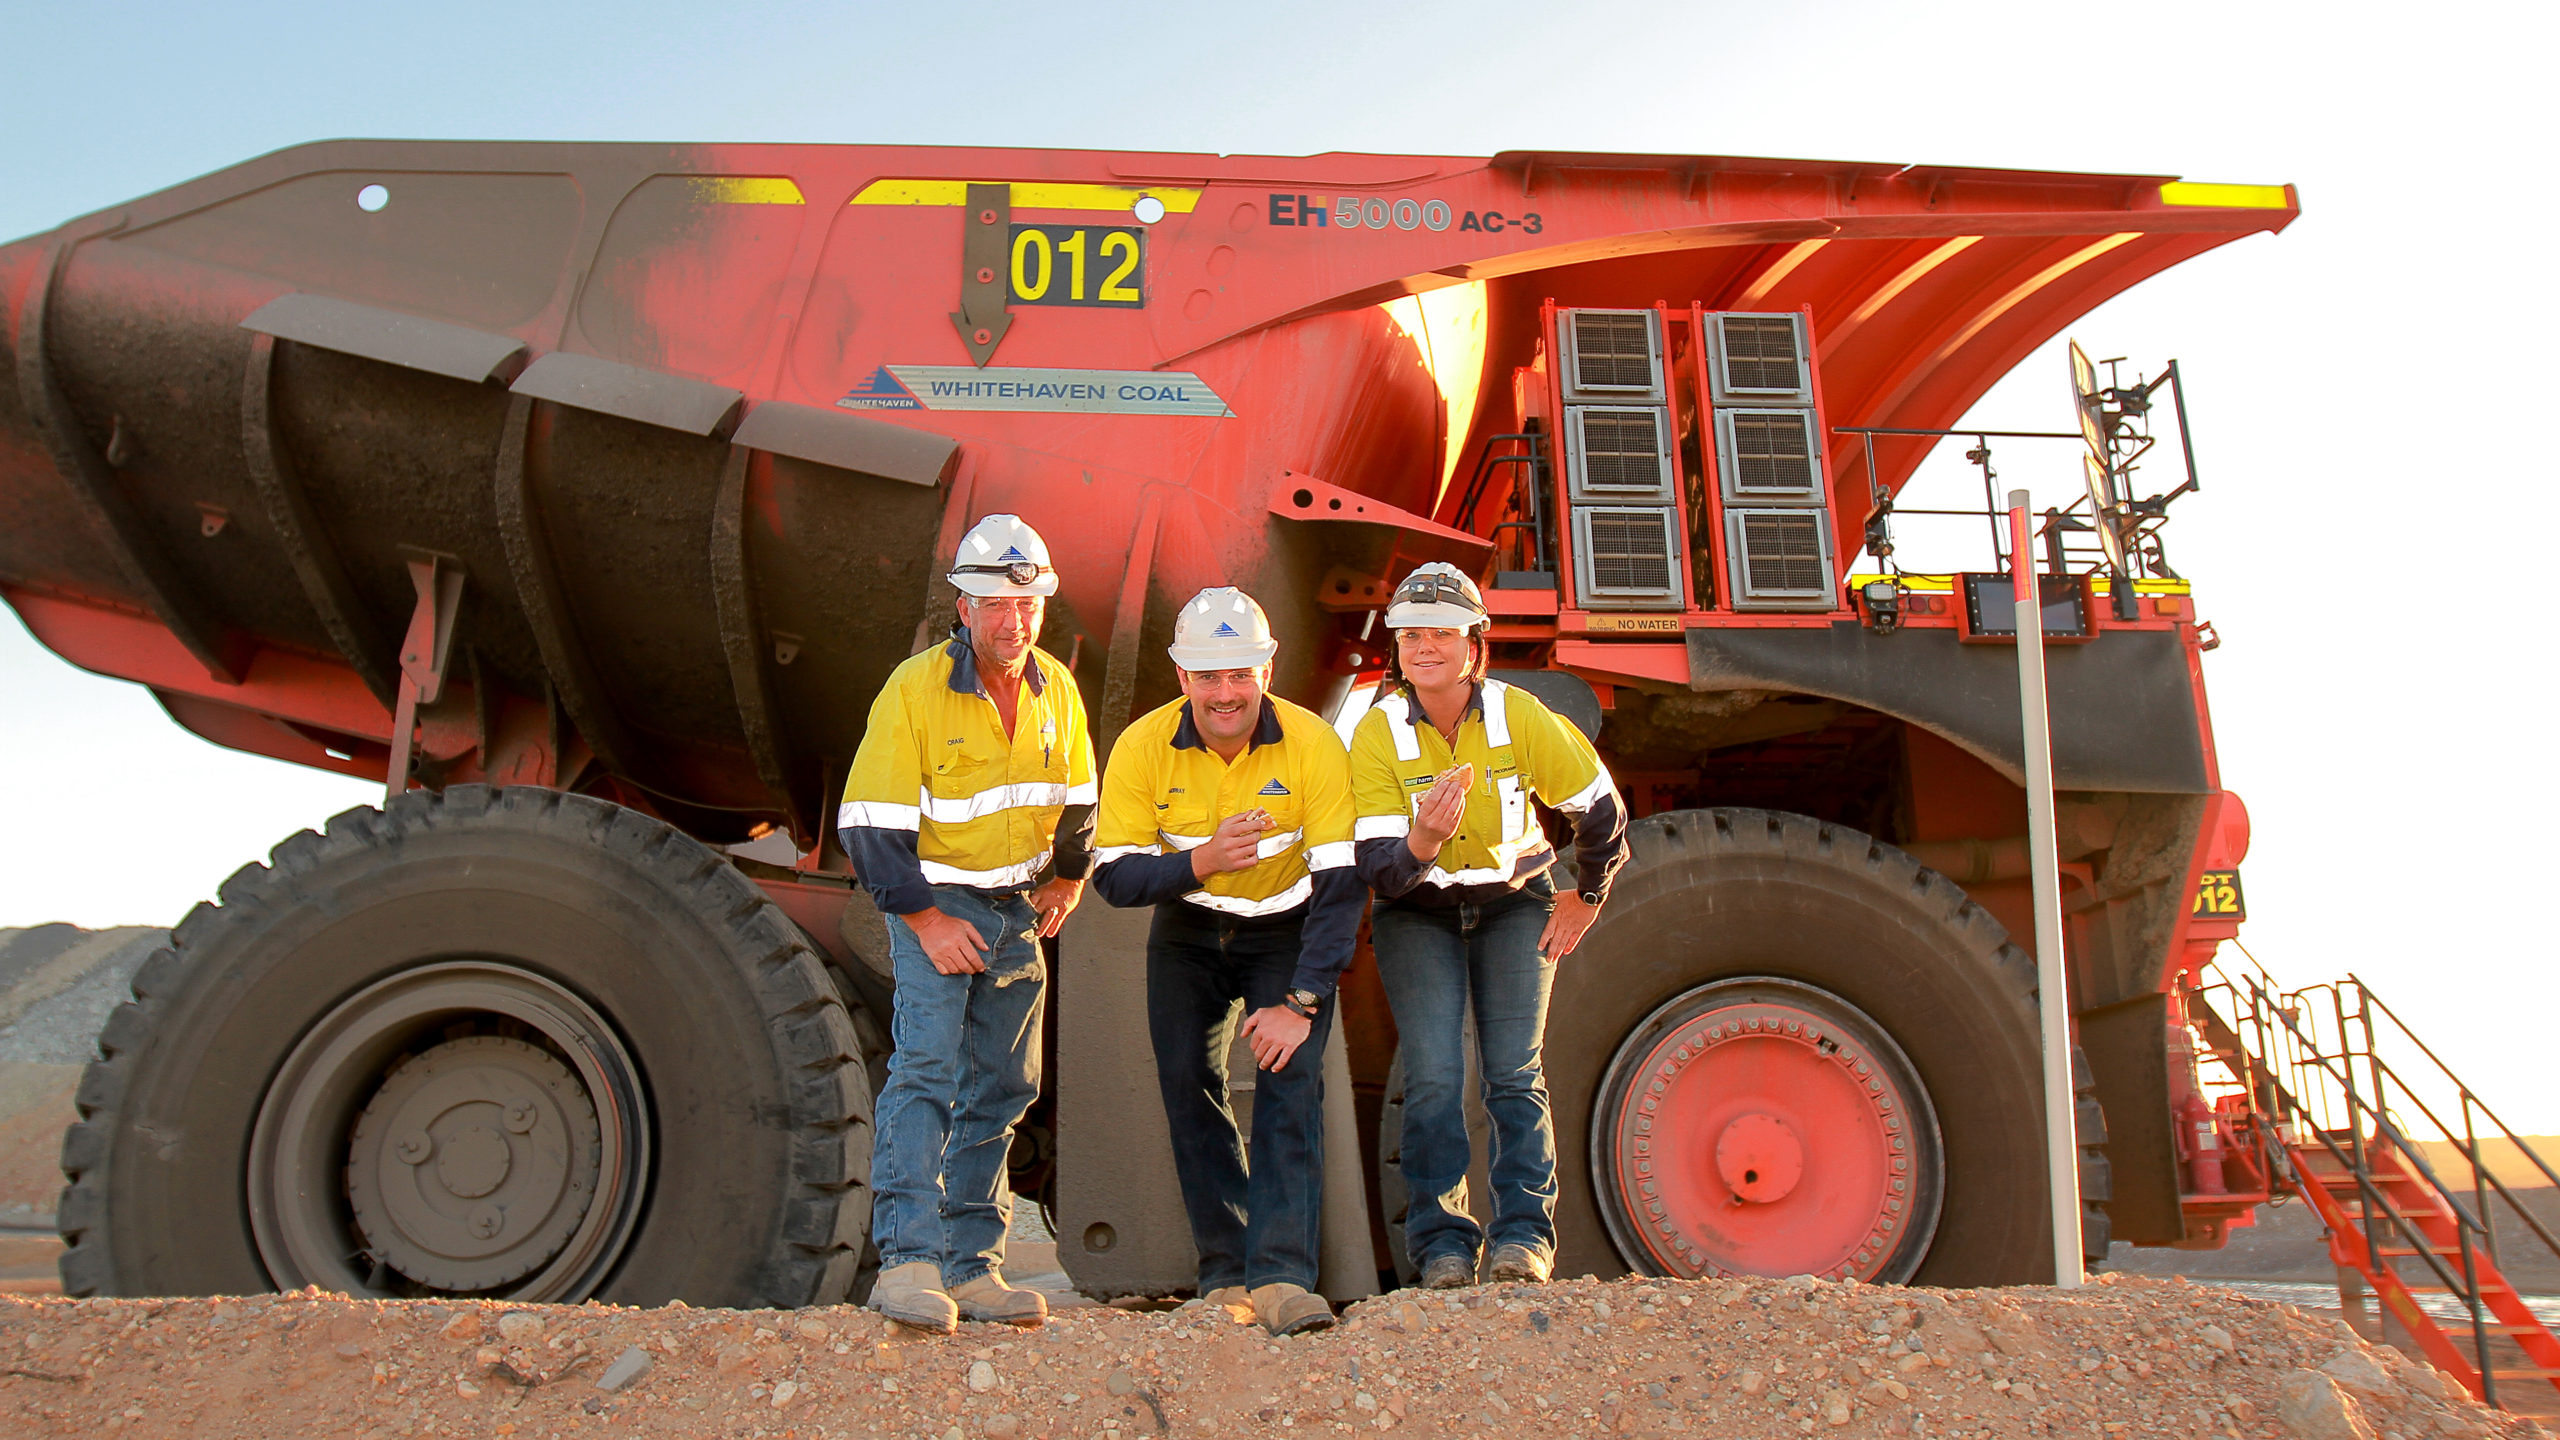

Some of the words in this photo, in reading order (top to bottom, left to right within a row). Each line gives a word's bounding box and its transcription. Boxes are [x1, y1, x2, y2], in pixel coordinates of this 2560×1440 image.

[1334, 197, 1452, 232] 5000
[1459, 211, 1543, 235] AC-3
[1010, 228, 1140, 302] 012
[930, 381, 1106, 400] WHITEHAVEN
[1118, 385, 1190, 402] COAL
[1618, 619, 1636, 630] NO
[1637, 619, 1679, 630] WATER
[2200, 874, 2234, 885] DT
